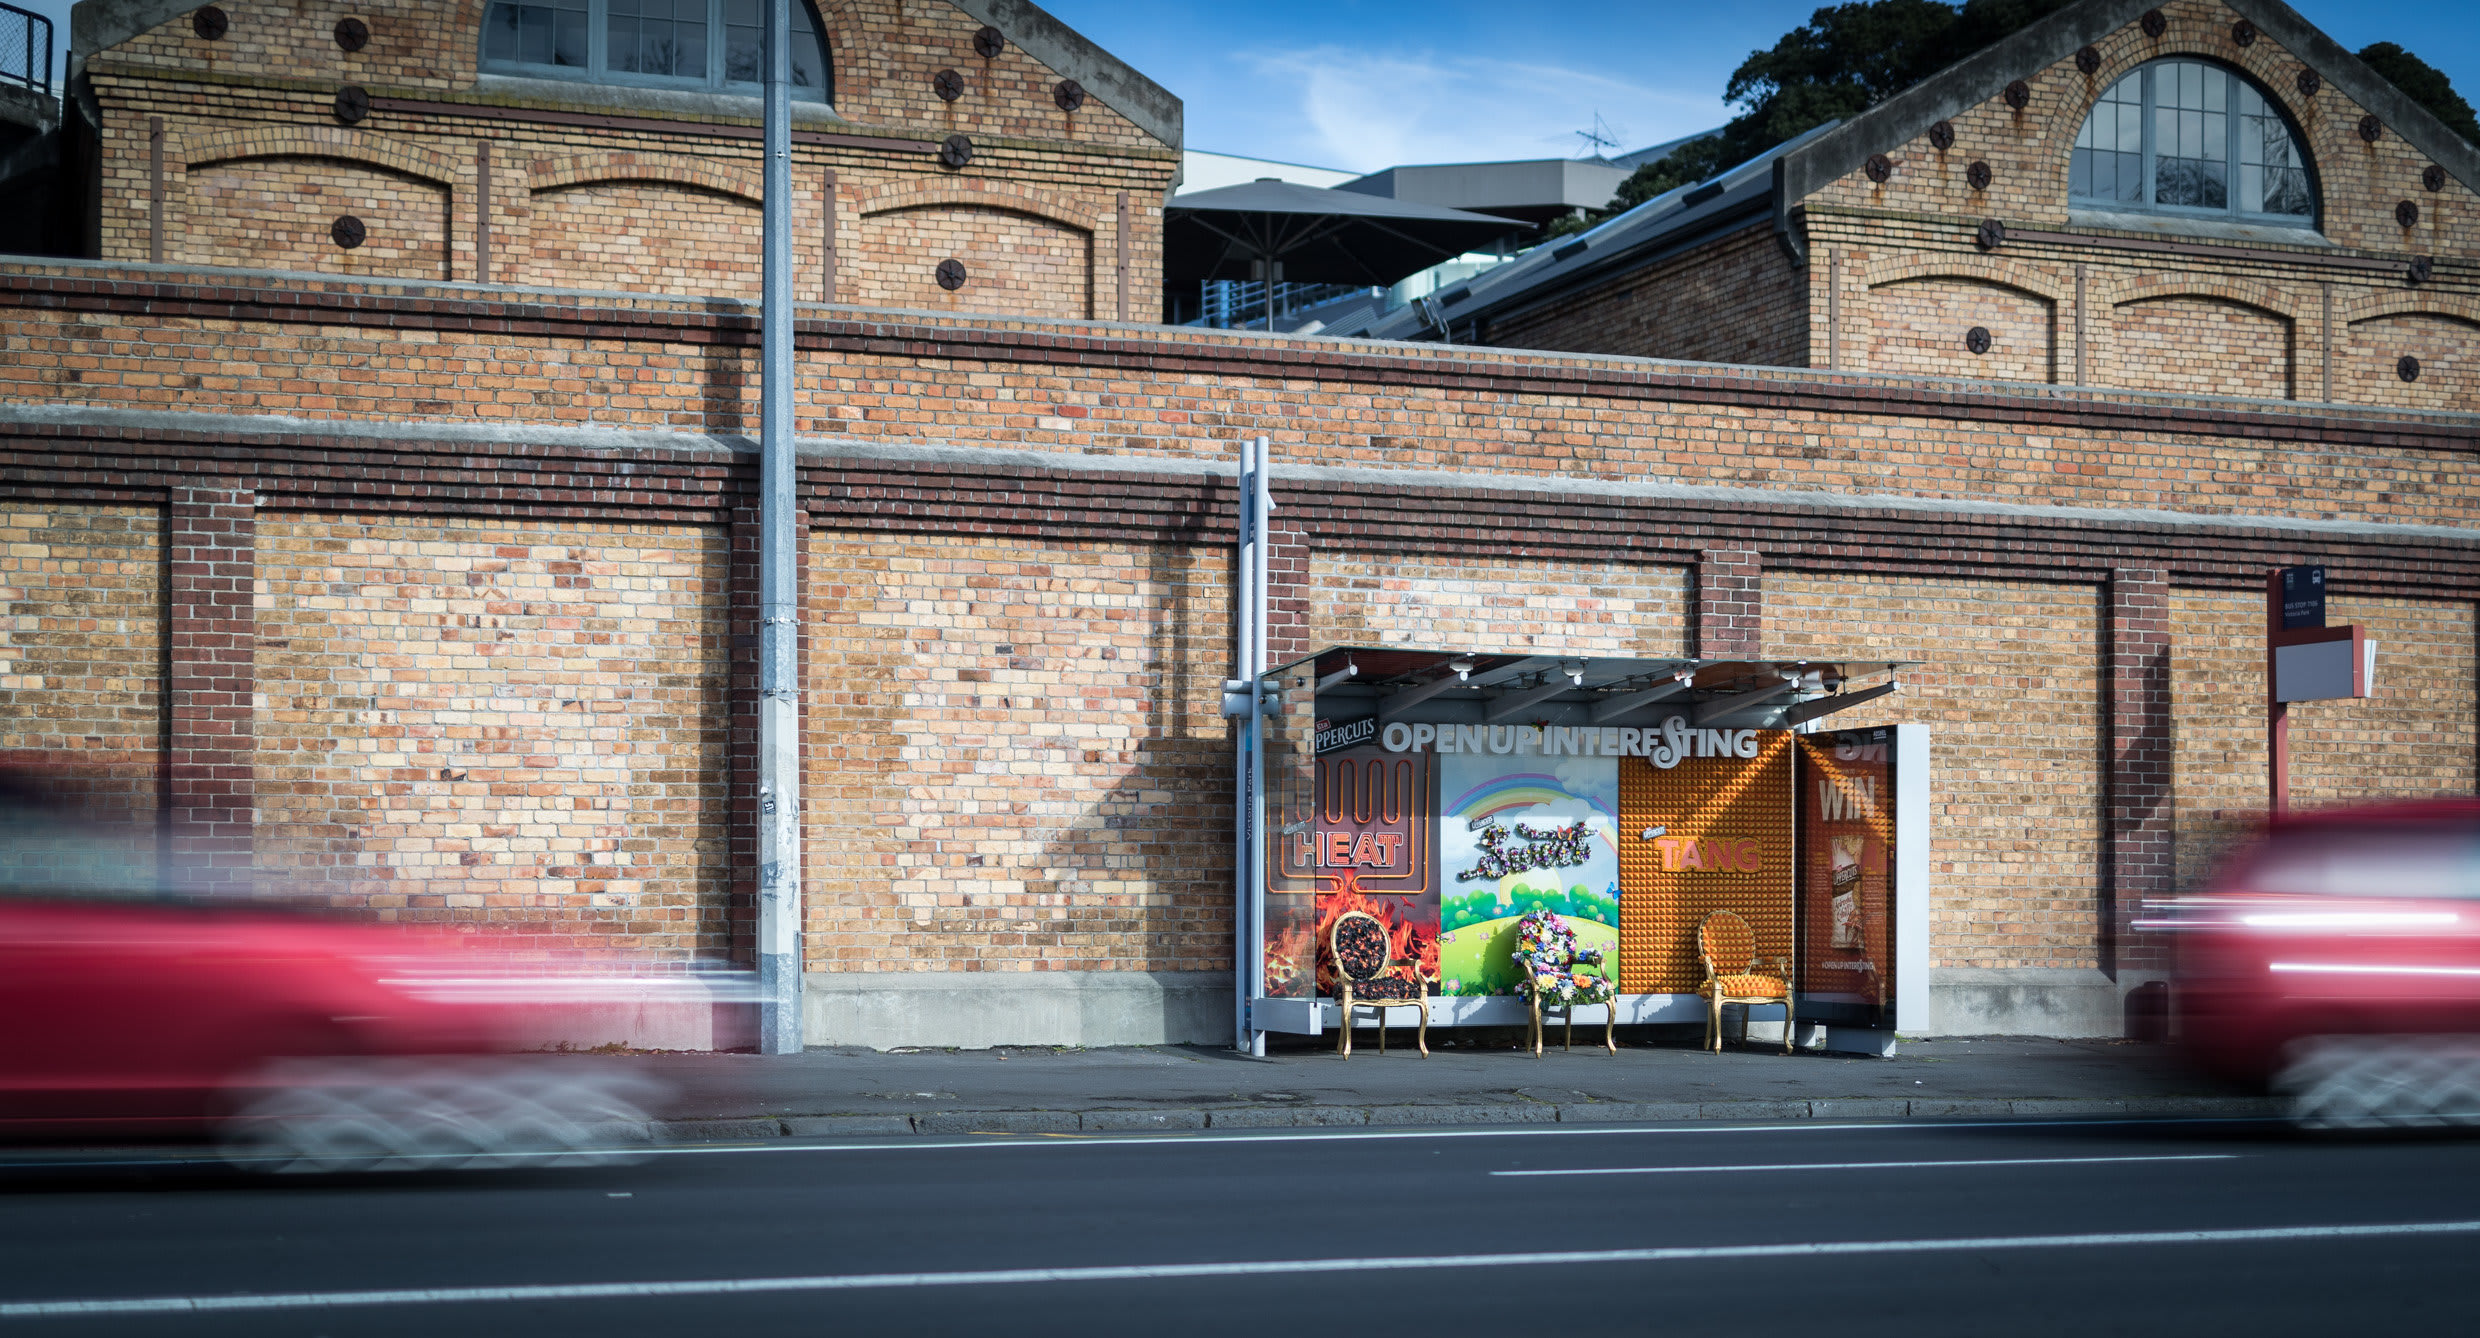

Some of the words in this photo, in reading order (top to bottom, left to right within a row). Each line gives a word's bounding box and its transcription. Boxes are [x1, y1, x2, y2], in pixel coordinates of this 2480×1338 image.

[2285, 602, 2294, 610] BUS
[1316, 718, 1375, 749] PPERCUTS
[1382, 722, 1482, 753] OPEN
[1489, 724, 1538, 754] UP
[1543, 715, 1758, 769] INTERESTING
[1818, 775, 1875, 822] WIN
[1294, 832, 1403, 867] HEAT
[1655, 837, 1761, 872] TANG
